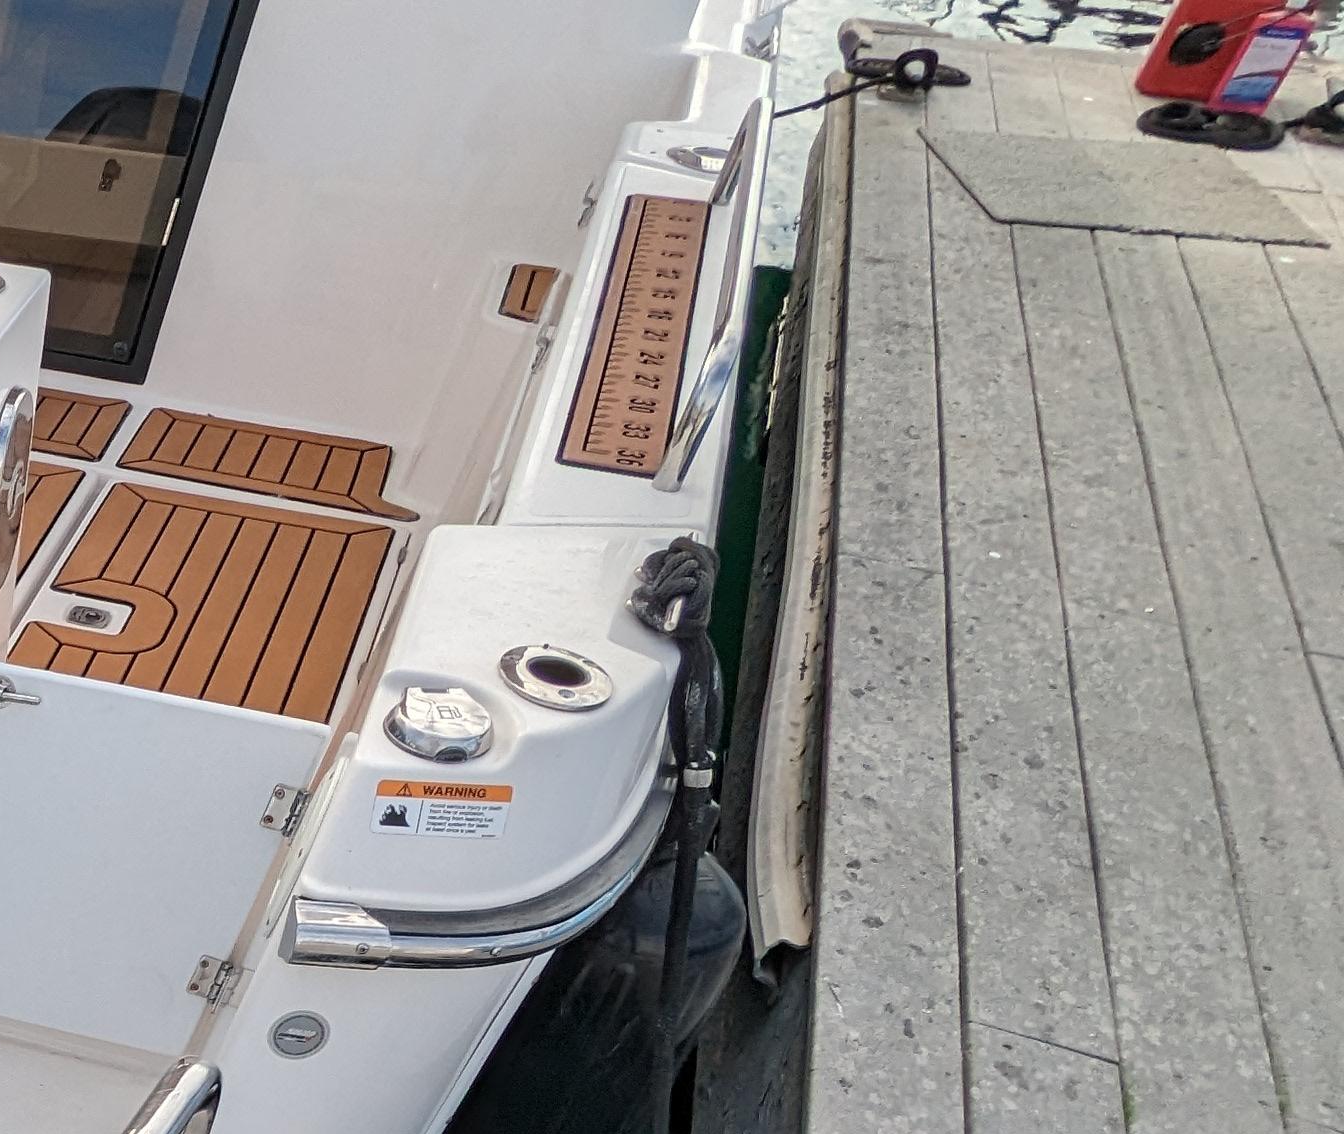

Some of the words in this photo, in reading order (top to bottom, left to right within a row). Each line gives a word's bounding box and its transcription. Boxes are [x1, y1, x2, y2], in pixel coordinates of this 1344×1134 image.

[638, 351, 665, 366] 24
[633, 373, 660, 390] 27
[628, 396, 657, 414] 30
[622, 422, 652, 440] 33
[616, 447, 646, 467] 36
[422, 785, 487, 799] WARNING
